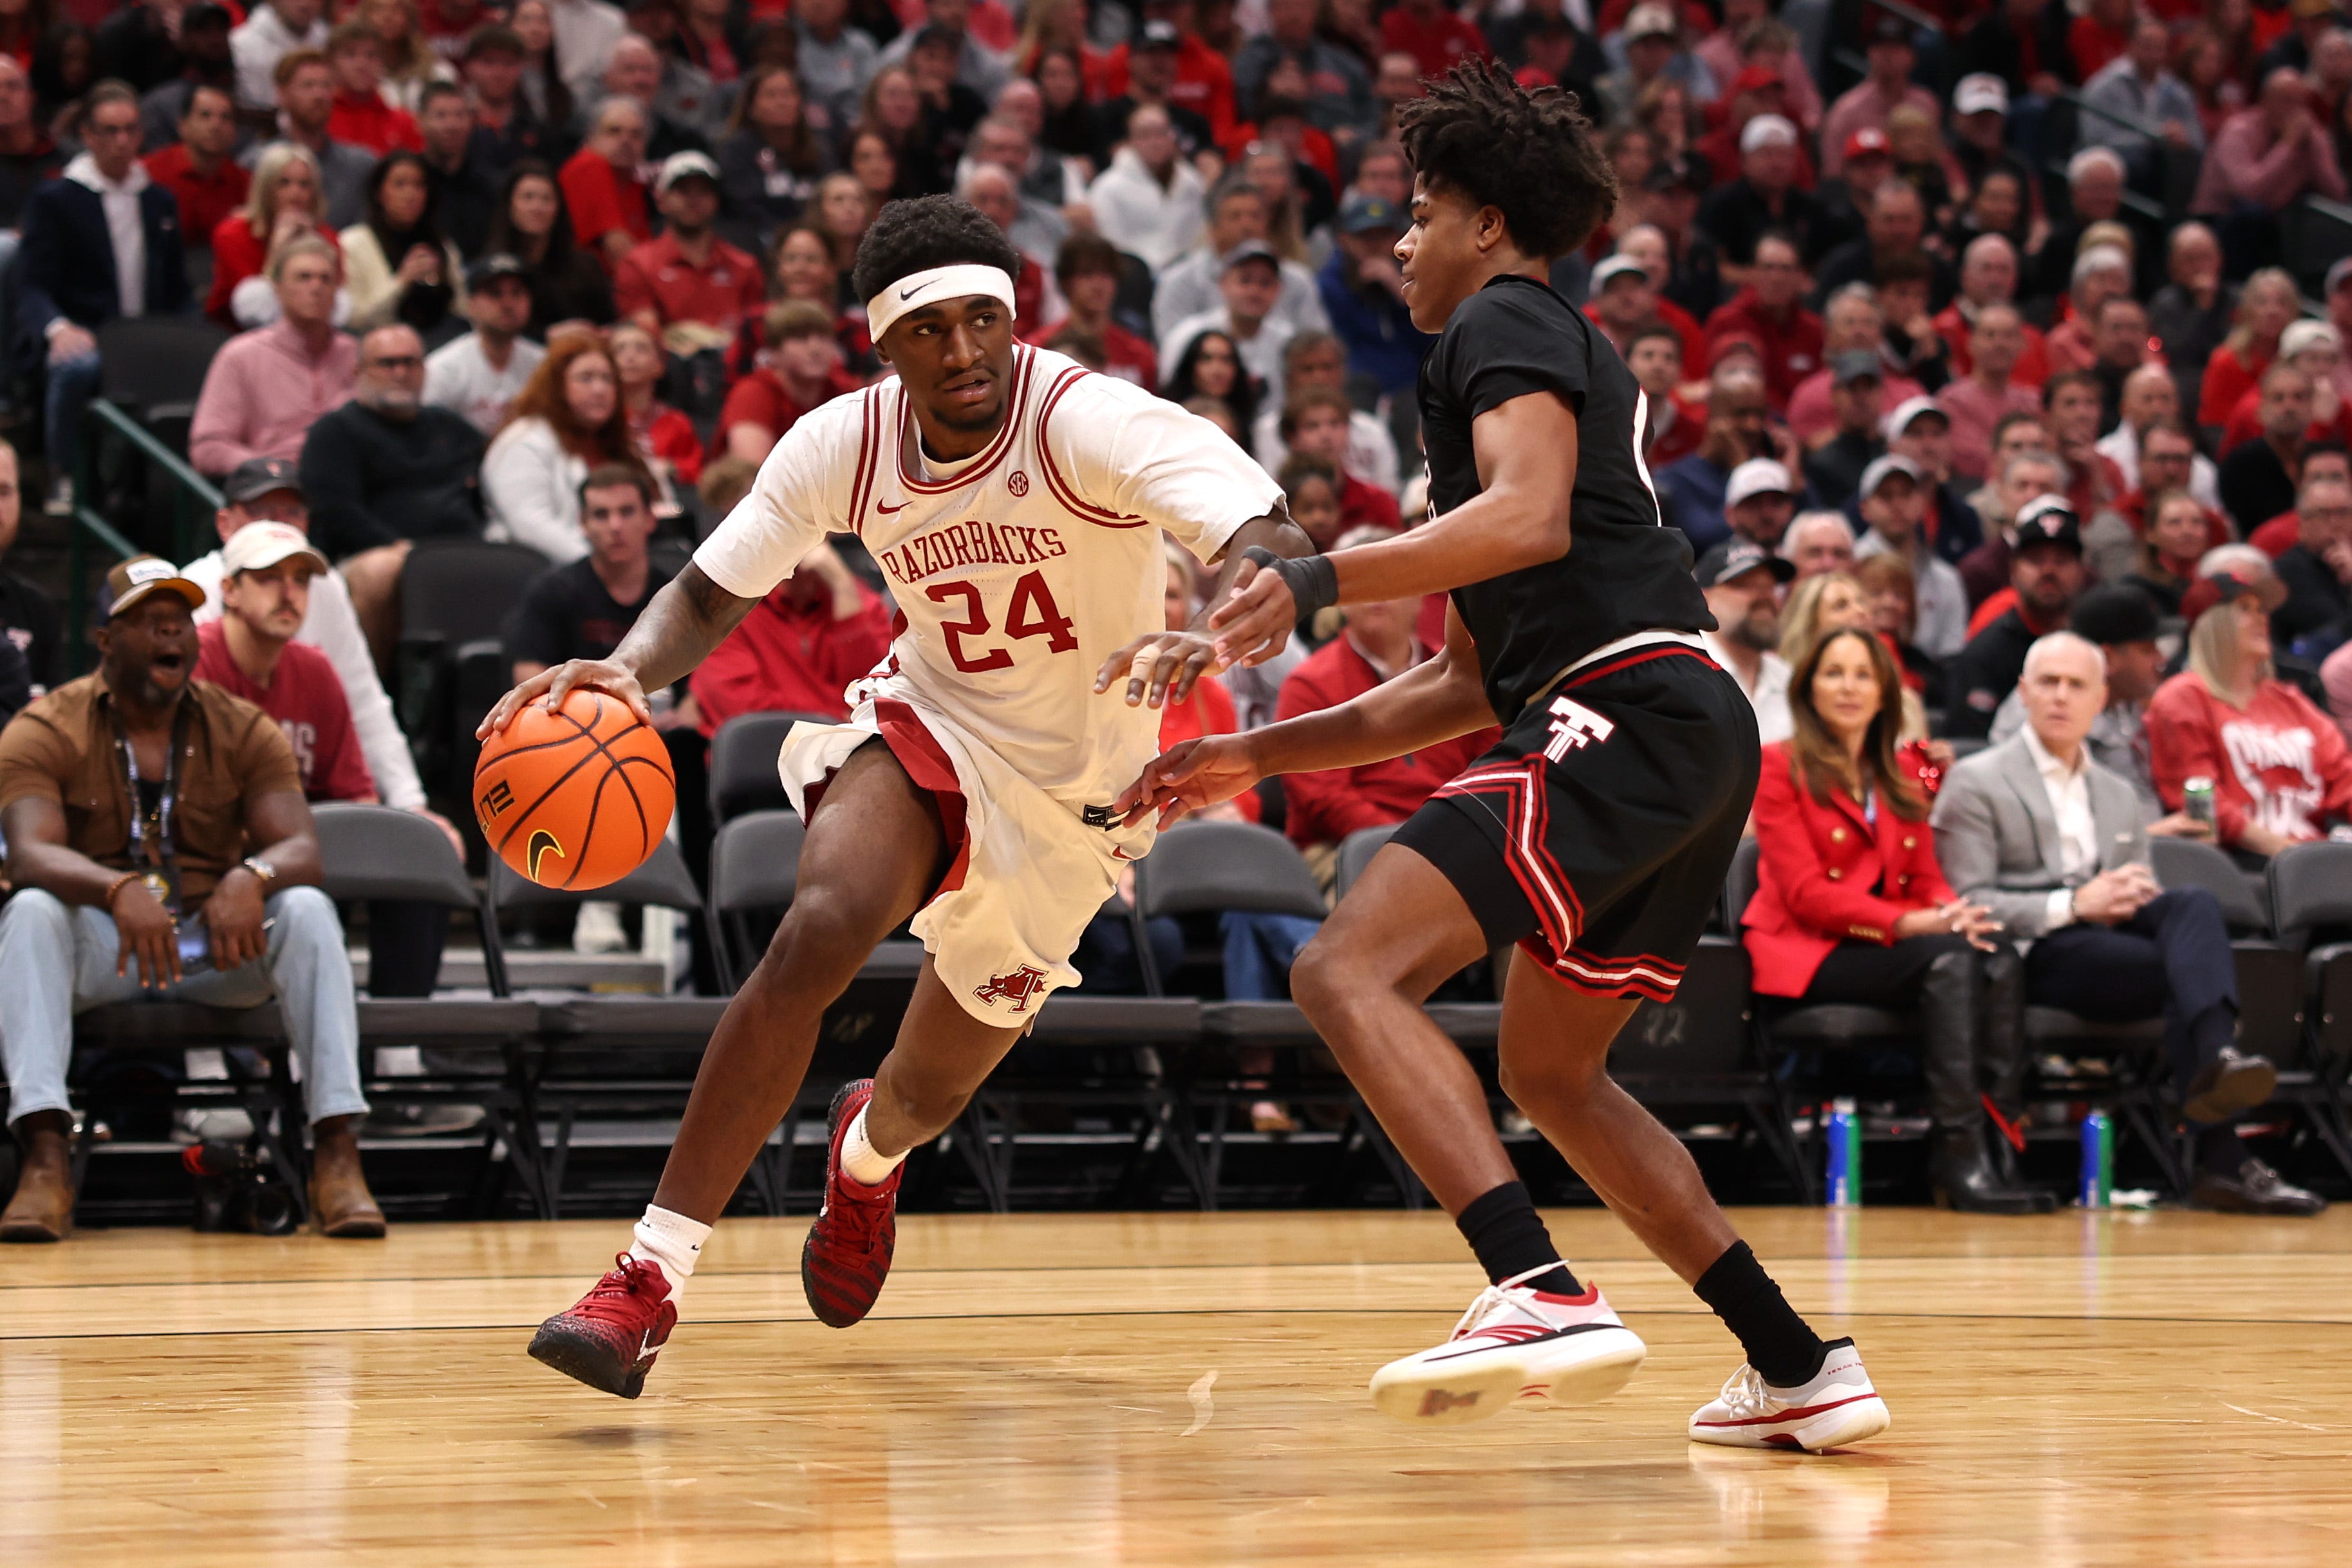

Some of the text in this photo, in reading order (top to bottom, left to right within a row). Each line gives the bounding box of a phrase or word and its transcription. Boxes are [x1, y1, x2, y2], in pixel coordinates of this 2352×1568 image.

[1009, 471, 1029, 496] SEC
[881, 521, 1067, 584] RAZORBACKS
[924, 568, 1079, 673] 24
